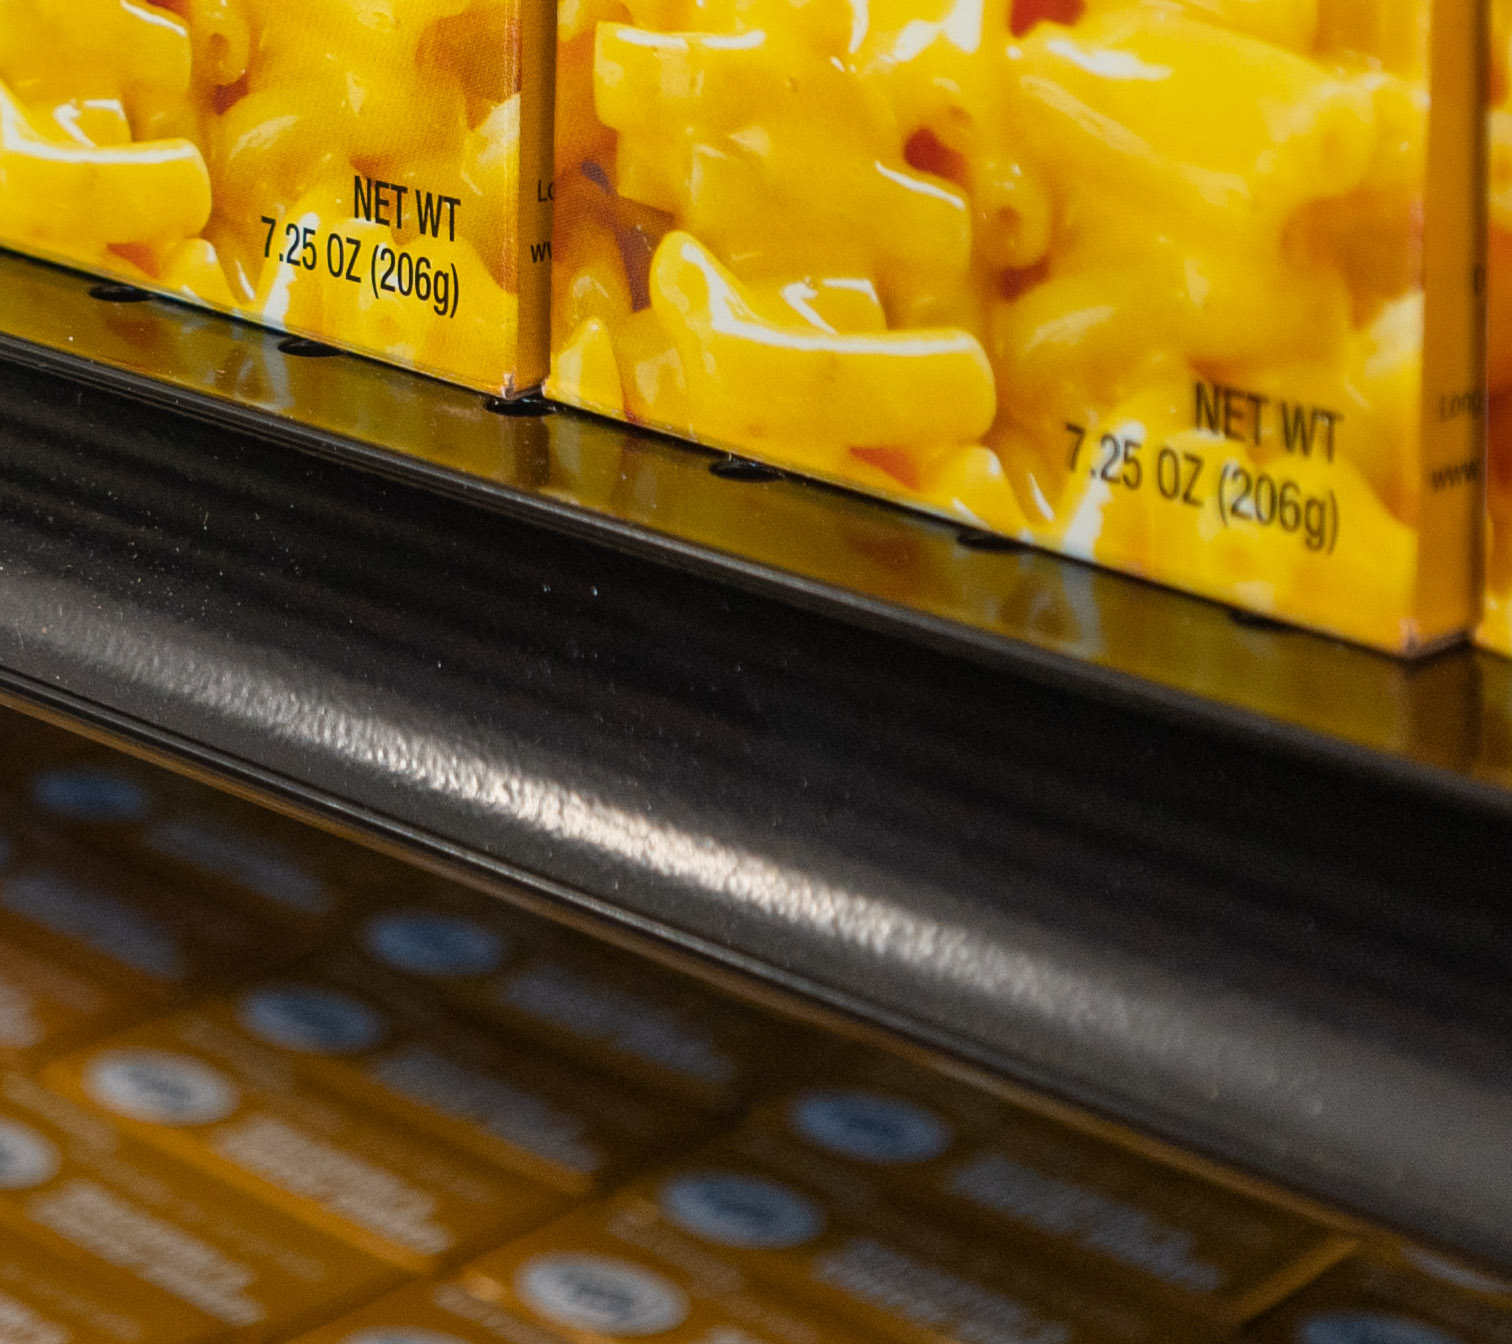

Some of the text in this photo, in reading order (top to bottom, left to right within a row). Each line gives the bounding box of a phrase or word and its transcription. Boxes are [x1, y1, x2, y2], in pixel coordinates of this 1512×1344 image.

[354, 175, 461, 242] NET WT
[261, 215, 460, 319] 7.25 OZ (206g)
[1193, 381, 1345, 464] NET WT
[1065, 422, 1341, 556] 7.25 OZ (206g)
